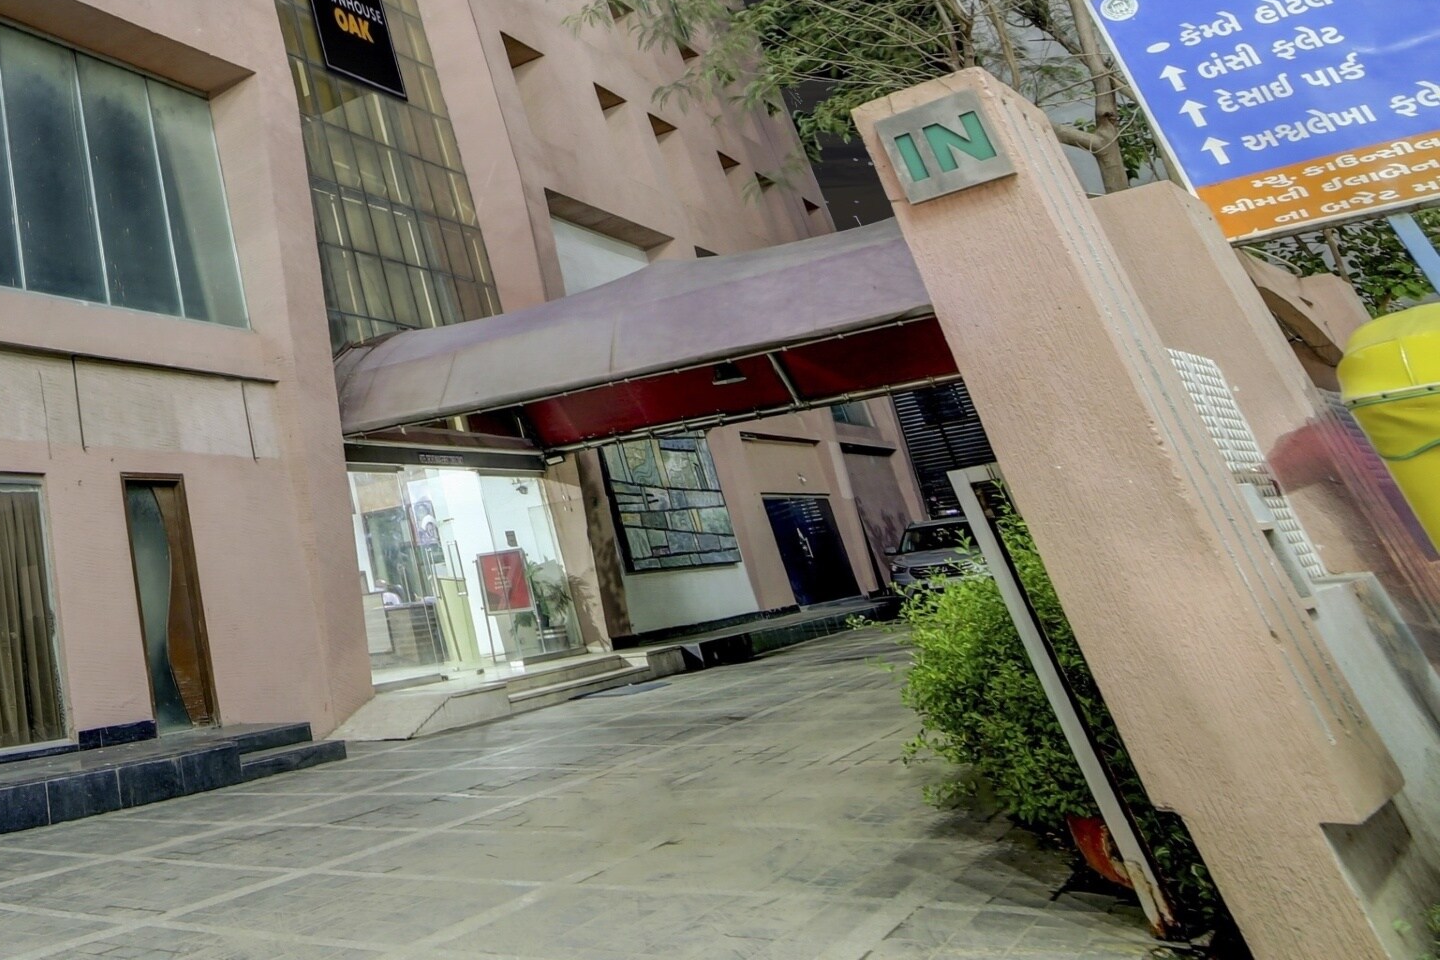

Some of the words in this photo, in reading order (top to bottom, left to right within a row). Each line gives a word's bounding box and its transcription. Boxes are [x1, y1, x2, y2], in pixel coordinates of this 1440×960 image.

[334, 6, 375, 44] OAK
[1179, 11, 1242, 47] કેમ્બે
[1197, 43, 1262, 80] બંસી
[1213, 73, 1295, 114] દેસાઈ
[1301, 52, 1366, 89] પાર્ક
[1389, 80, 1440, 117] ફલે
[894, 110, 997, 182] IN
[1302, 137, 1440, 176] કાઉન્સીલ
[1220, 186, 1310, 215] શ્રીમતી
[1274, 208, 1310, 223] ના
